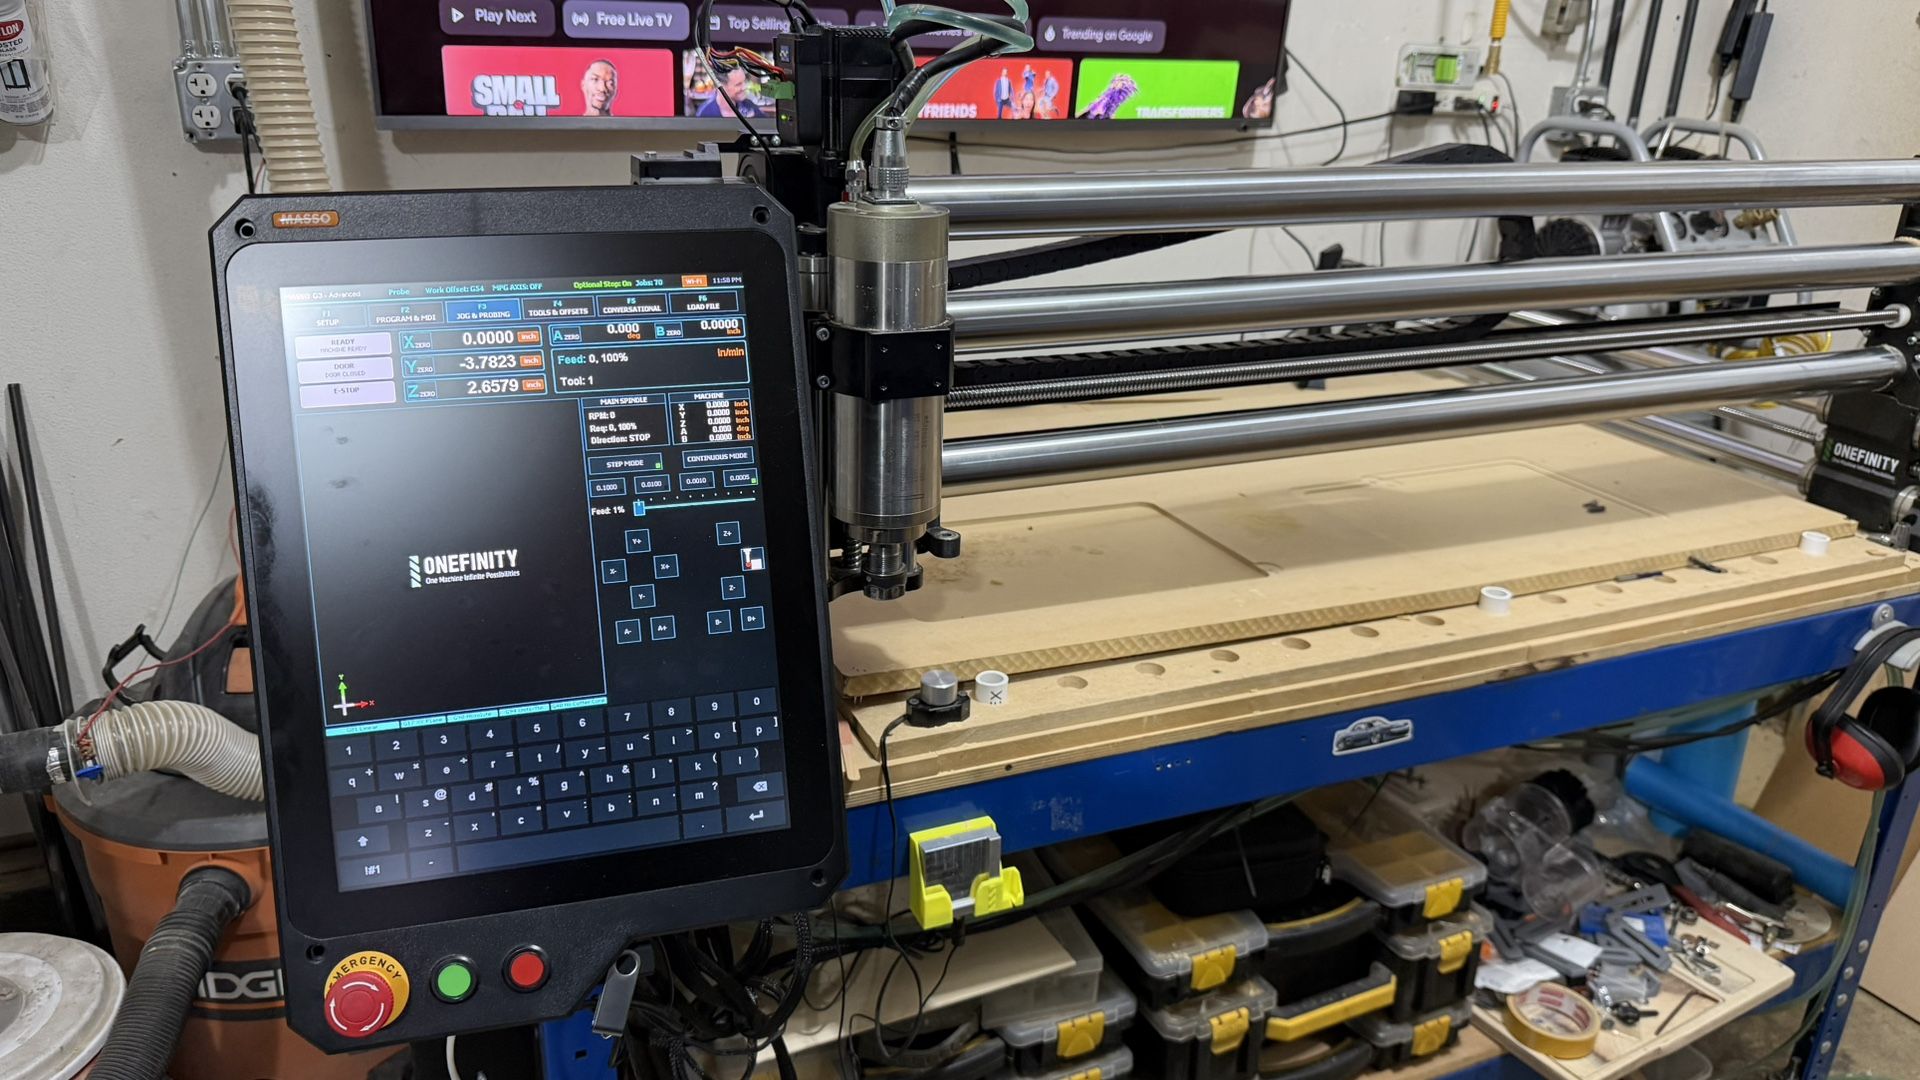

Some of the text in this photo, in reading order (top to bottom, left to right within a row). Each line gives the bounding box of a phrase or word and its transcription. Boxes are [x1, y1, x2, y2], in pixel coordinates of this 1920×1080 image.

[475, 8, 537, 25] Play Next
[596, 11, 673, 27] Free Live TV
[0, 23, 19, 36] LON
[728, 16, 790, 32] Top Selling
[1062, 28, 1153, 44] Trending on Google
[472, 75, 560, 106] SMALL
[279, 212, 331, 225] MASSO
[470, 285, 484, 293] G54
[573, 281, 602, 289] Optional
[603, 281, 621, 289] Stop:
[635, 279, 653, 287] Jobs:
[389, 288, 409, 296] Probe
[603, 305, 661, 314] CONVERSATIONAL
[316, 319, 339, 327] SETUP
[376, 315, 412, 323] PROGRAM
[553, 330, 563, 341] A
[607, 324, 639, 334] 0.000
[656, 326, 665, 336] B
[700, 319, 738, 330] 0.0000
[403, 336, 415, 349] X
[463, 331, 514, 345] 0.0000
[627, 333, 641, 341] deg
[558, 347, 744, 365] Feed: 0, 100% in/min
[405, 360, 417, 373] Y
[459, 355, 516, 370] -3.7823
[560, 375, 593, 387] Tool: 1
[407, 385, 418, 398] Z
[467, 379, 519, 394] 2.6579
[600, 396, 648, 405] MAIN SPINDLE
[694, 392, 724, 400] MACHINE
[678, 403, 684, 411] X
[588, 412, 609, 421] RPM:
[679, 411, 685, 419] Y
[590, 424, 608, 433] Req:
[618, 422, 637, 431] 100%
[680, 420, 686, 428] Z
[591, 433, 650, 445] Direction: STOP
[624, 459, 644, 467] MODE
[687, 454, 728, 463] CONTINUOUS
[1833, 442, 1900, 474] ONEFINITY
[641, 480, 662, 488] 0.0100
[686, 477, 707, 485] 0.0010
[592, 506, 625, 516] Feed: 1%
[423, 549, 518, 575] ONEFINITY
[425, 570, 520, 585] One Machine Infinite Possibilities
[345, 696, 760, 756] 1 2 3 4 5 6 7 8 9 0
[348, 778, 356, 788] q
[394, 772, 405, 780] w
[443, 766, 450, 774] e
[490, 760, 496, 768] r
[537, 753, 542, 762] t
[581, 749, 589, 759] y
[756, 726, 763, 736] p
[375, 762, 702, 813] a s d f g h k
[425, 791, 704, 837] z x c v b n m
[364, 864, 381, 876] !#1
[329, 956, 402, 987] MERGENCY
